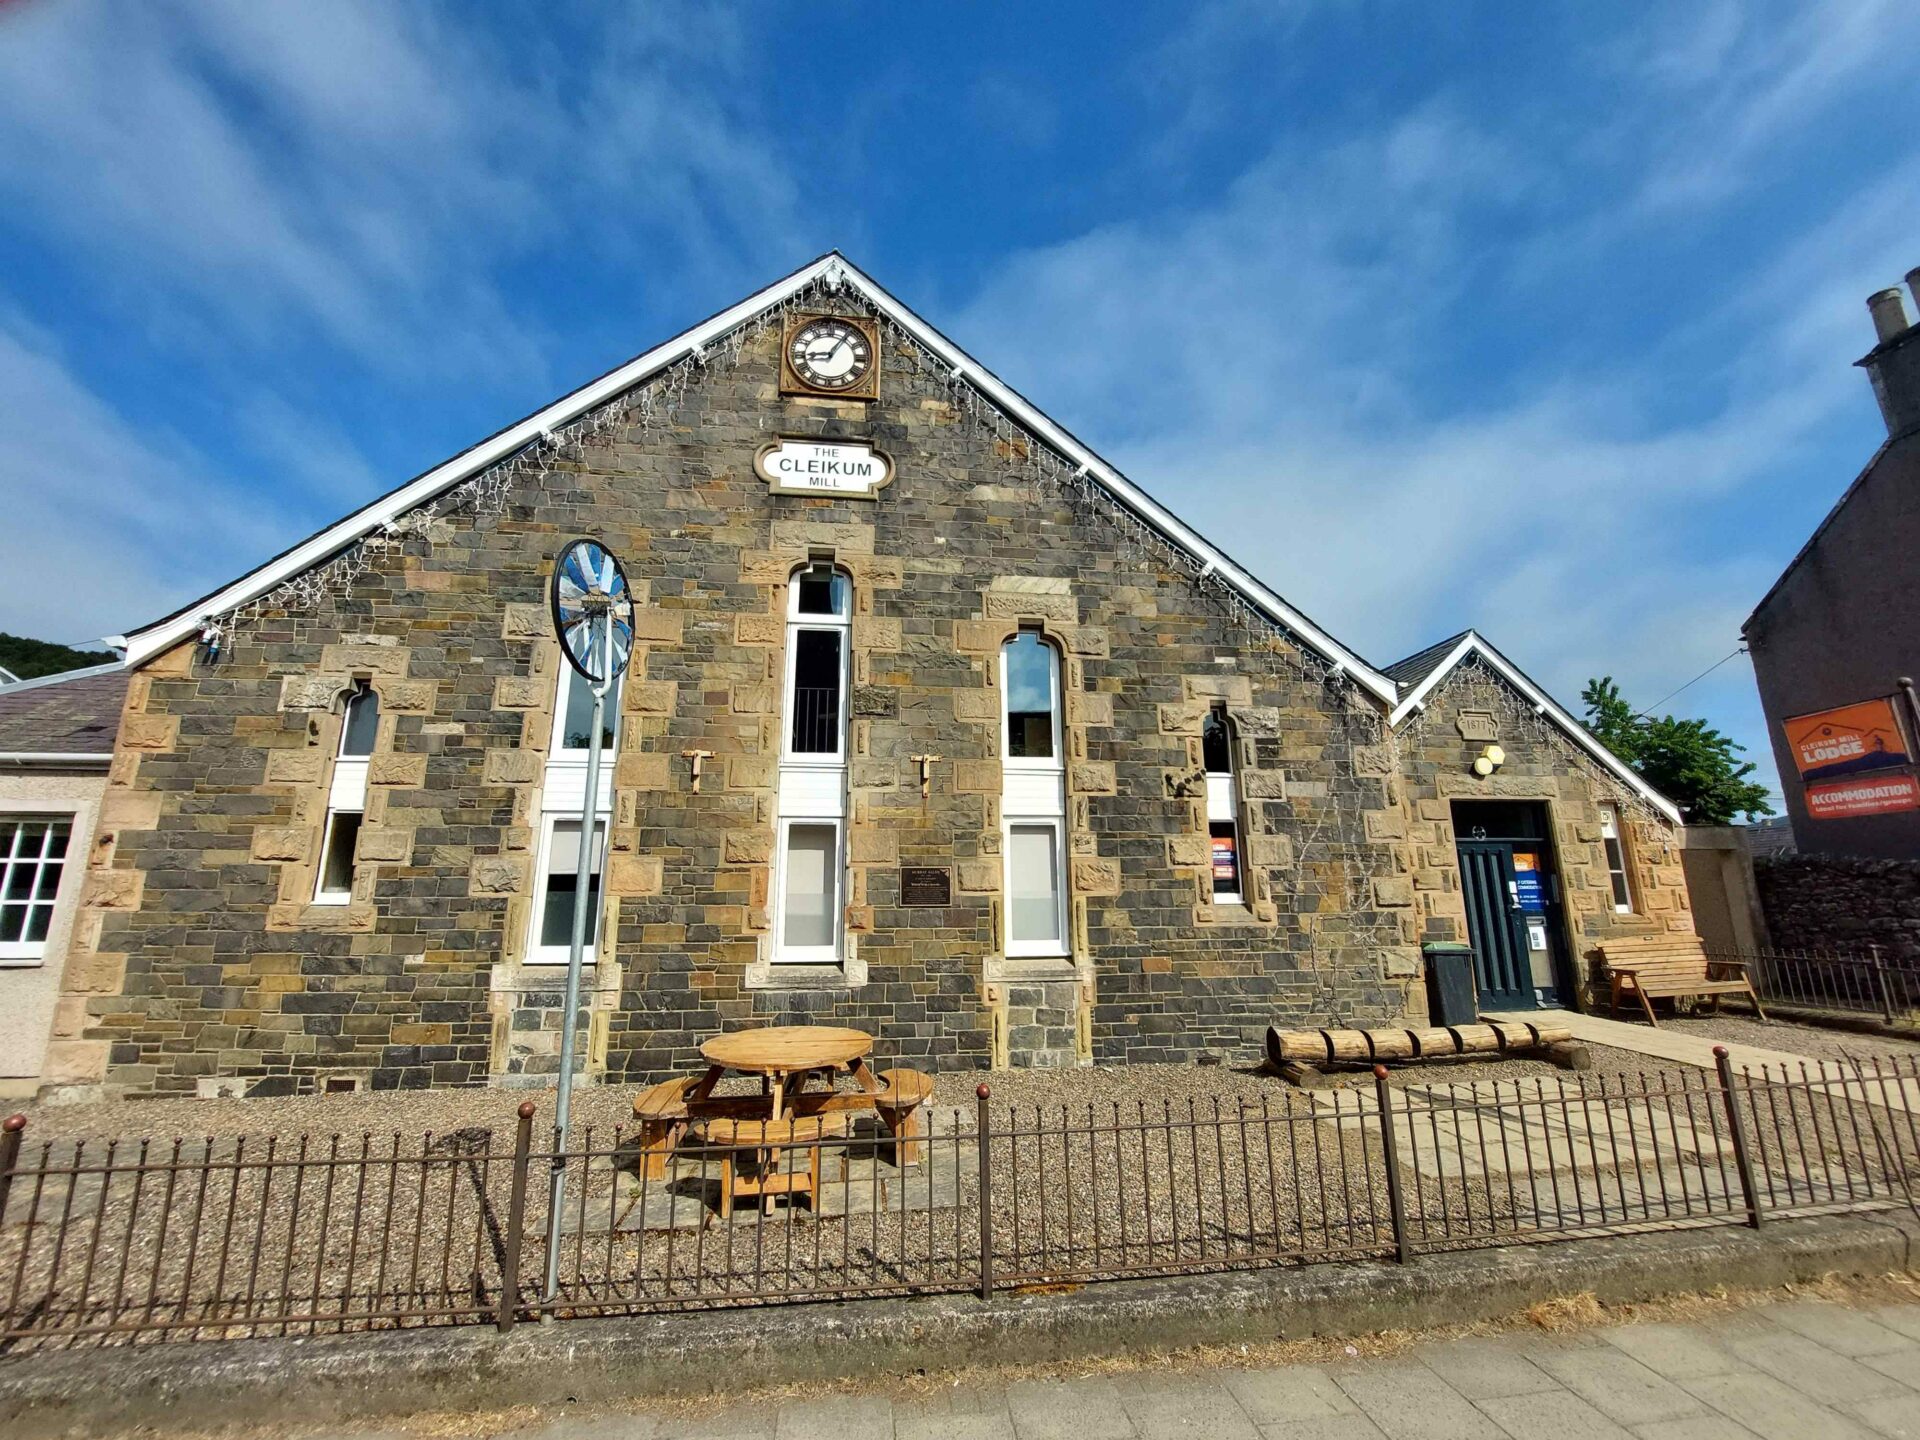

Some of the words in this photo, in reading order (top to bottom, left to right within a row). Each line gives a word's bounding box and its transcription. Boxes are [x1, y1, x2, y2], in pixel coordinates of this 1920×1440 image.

[813, 447, 839, 458] THE
[779, 458, 872, 477] CLEIKUM
[809, 476, 840, 487] MILL
[1467, 719, 1486, 730] 1877
[1800, 738, 1837, 752] CLEIKUM
[1838, 733, 1861, 744] MILL
[1803, 741, 1865, 763] LODGE
[1811, 784, 1913, 806] ACCOMMODATION
